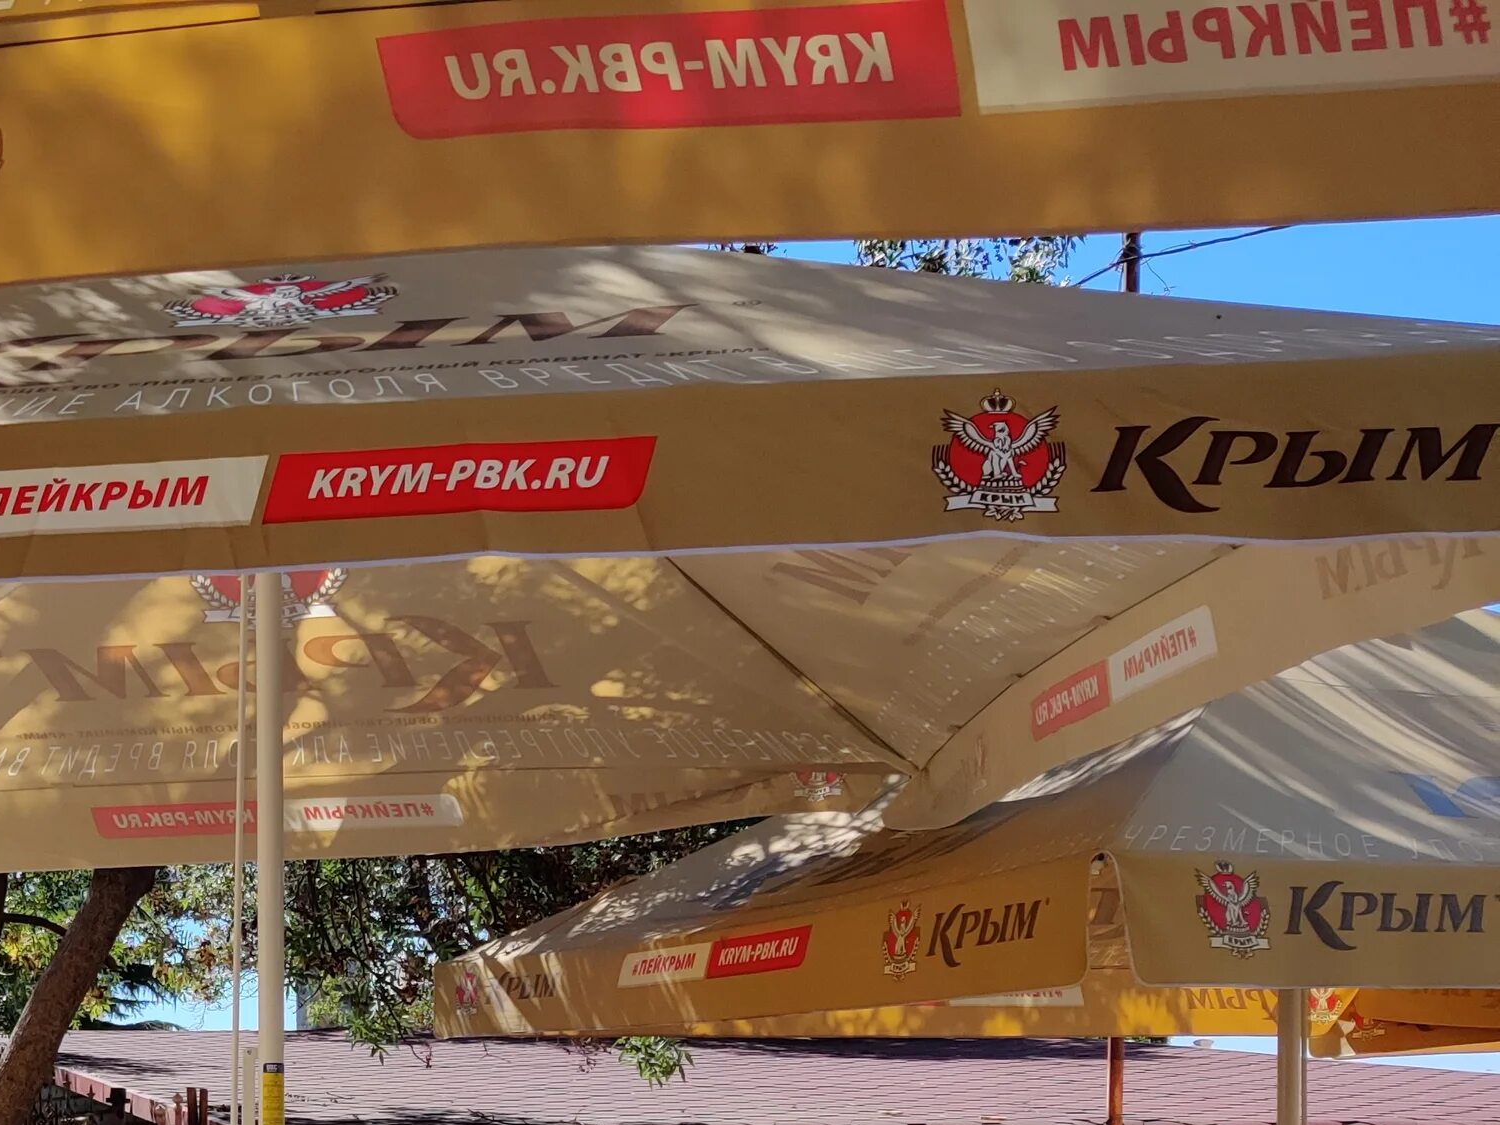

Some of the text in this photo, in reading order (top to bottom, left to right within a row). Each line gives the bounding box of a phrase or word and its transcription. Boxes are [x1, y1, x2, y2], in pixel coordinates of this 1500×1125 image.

[114, 373, 448, 412] АЛКОГОЛЯ
[478, 358, 746, 388] ВРЕДИТ
[307, 455, 610, 500] KRYM-PBK.RU
[631, 951, 696, 977] #ПЕЙКРЫМ
[717, 936, 800, 967] KRYM-PBK.RU
